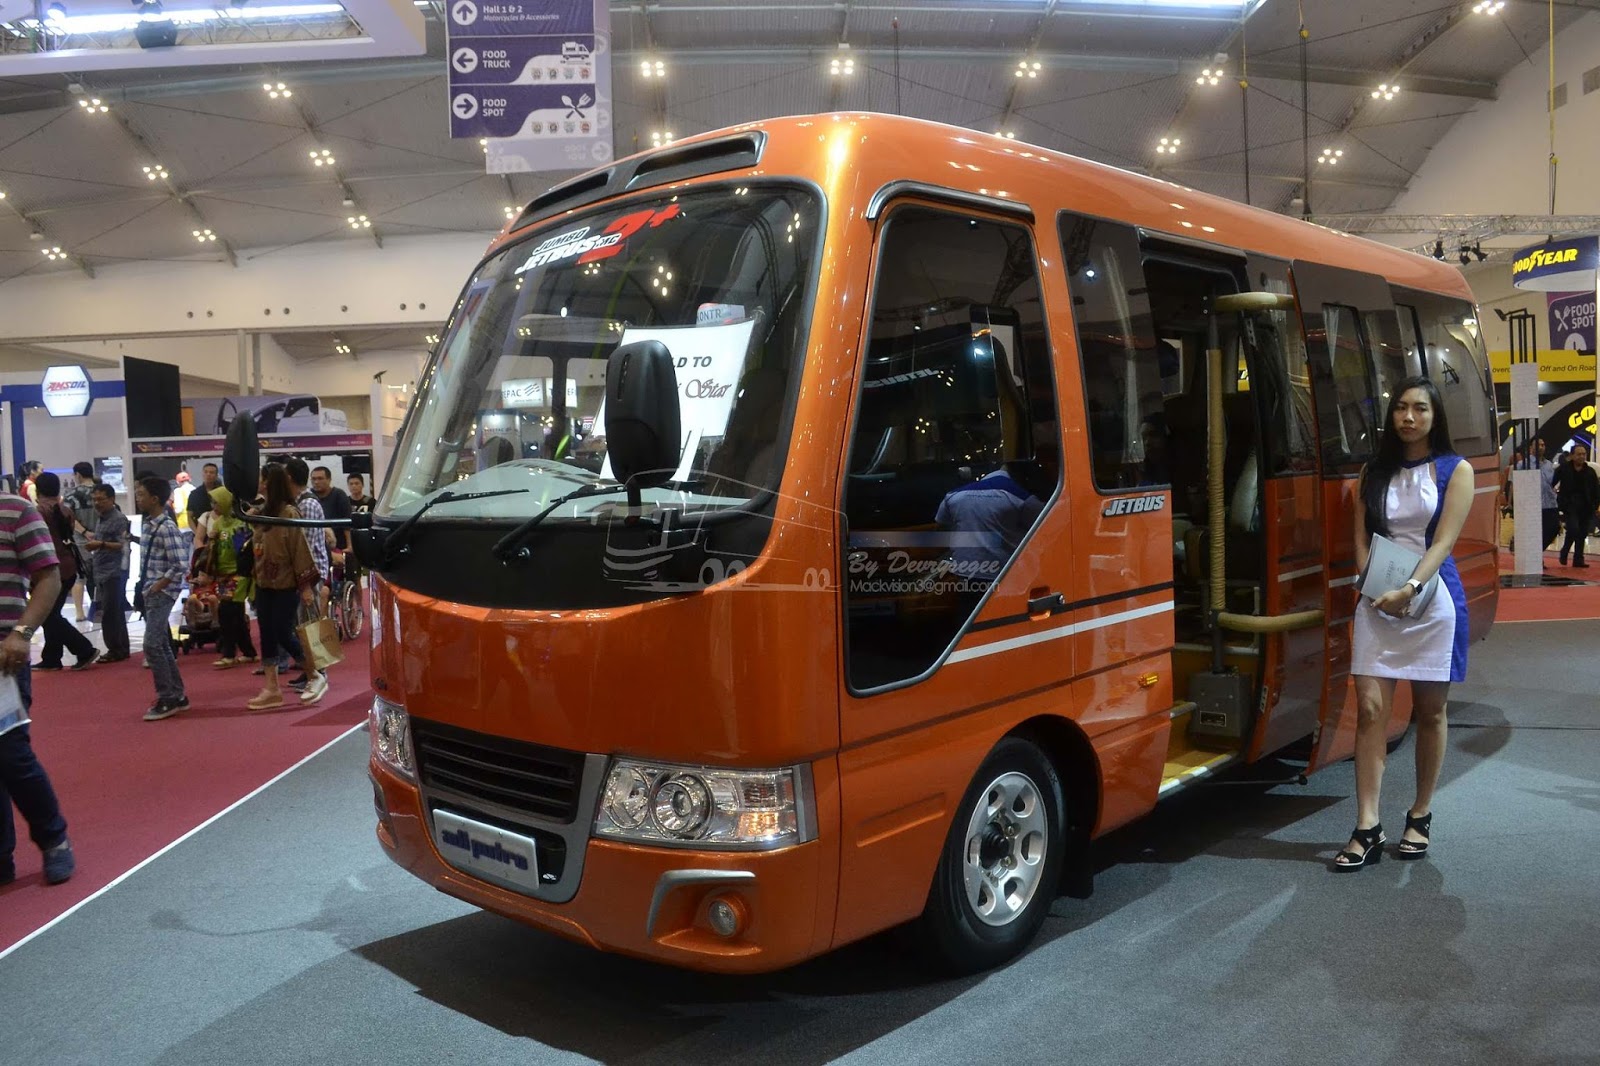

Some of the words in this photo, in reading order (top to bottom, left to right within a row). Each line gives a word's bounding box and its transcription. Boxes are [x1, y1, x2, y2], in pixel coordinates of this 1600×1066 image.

[483, 5, 500, 13] Hall
[508, 5, 516, 13] &
[517, 5, 523, 13] 2
[482, 50, 507, 58] FOOD
[483, 60, 511, 68] TRUCK
[482, 99, 507, 107] FOOD
[483, 108, 504, 117] SPOT
[532, 225, 590, 255] JUMBO
[514, 235, 601, 275] JETBUS
[1570, 302, 1596, 317] FOOD
[1571, 314, 1595, 329] SPOT
[692, 356, 712, 367] TO
[47, 380, 86, 392] AMSOIL
[685, 378, 732, 399] Star
[1568, 405, 1597, 429] GO
[1103, 495, 1166, 517] JETBUS
